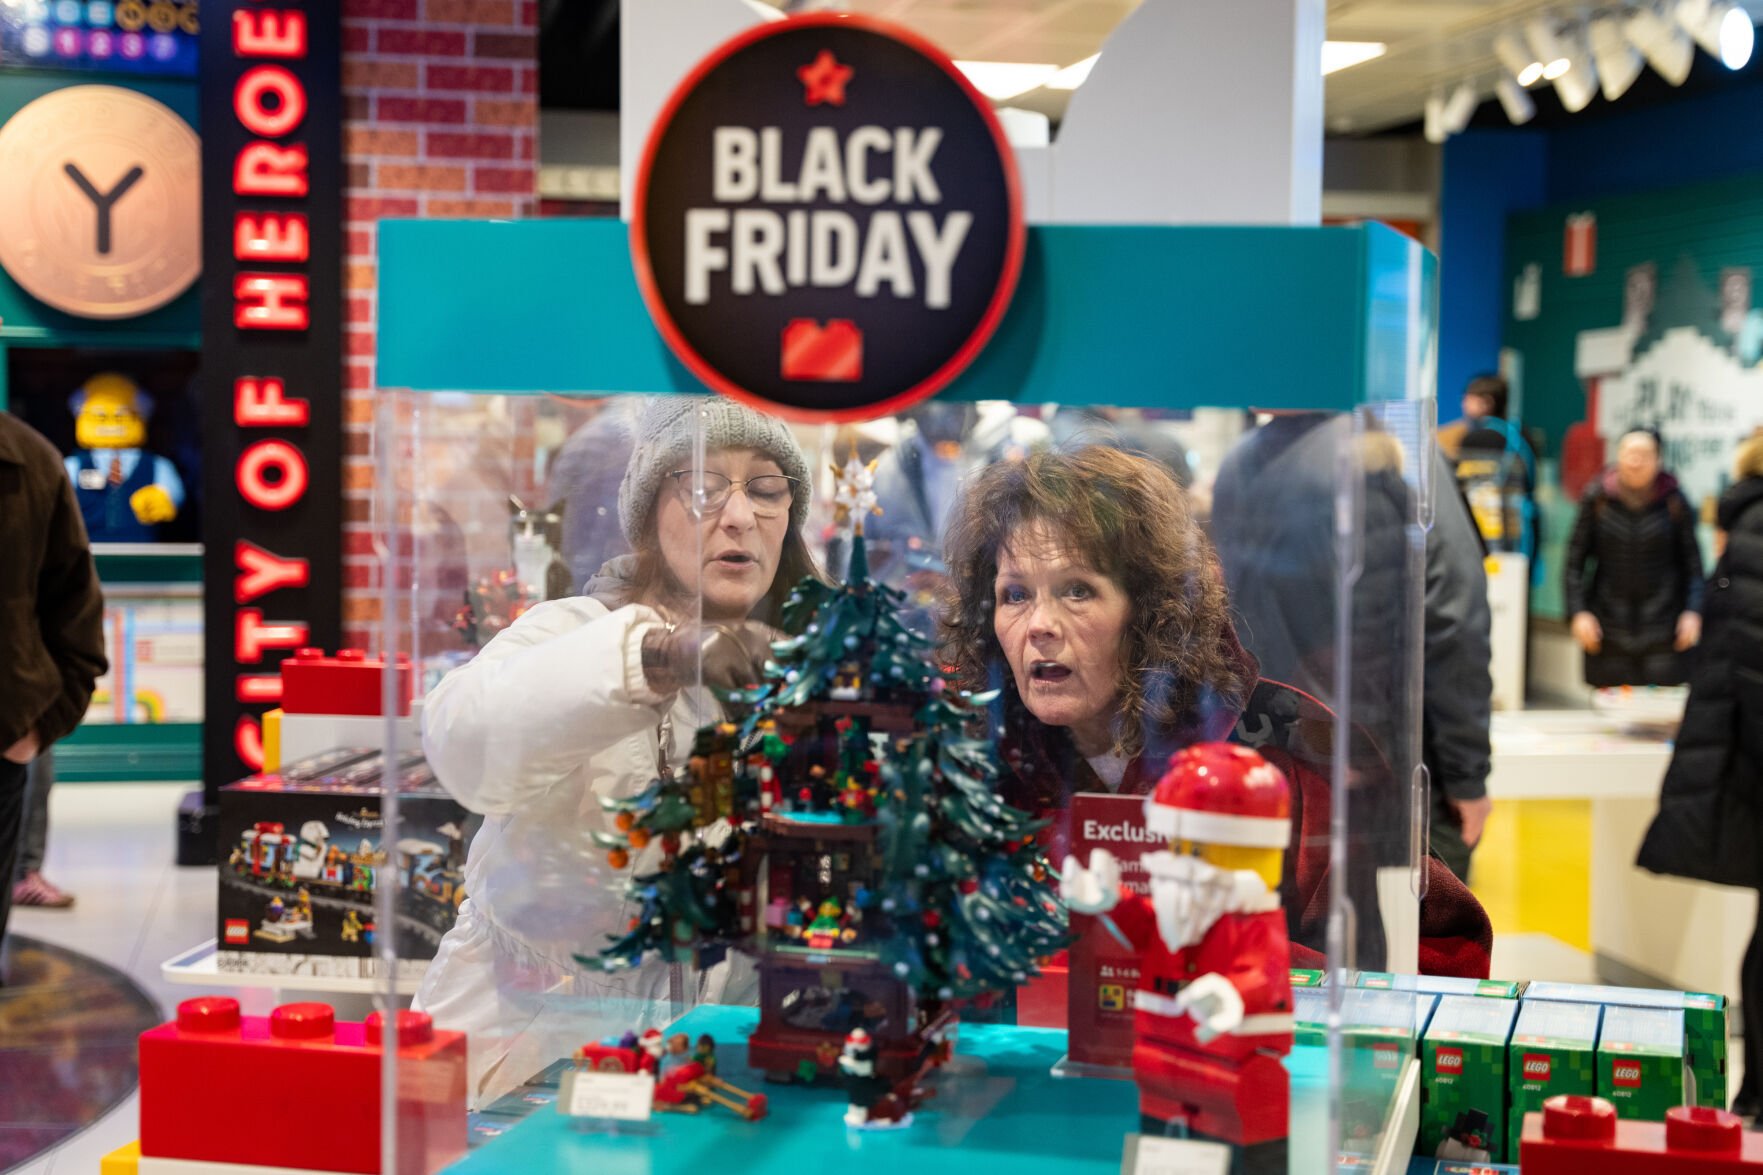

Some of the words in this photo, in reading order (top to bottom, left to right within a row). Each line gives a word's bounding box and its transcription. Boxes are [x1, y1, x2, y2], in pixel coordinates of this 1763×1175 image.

[232, 0, 309, 331] HEROE
[713, 127, 943, 203] BLACK
[64, 162, 144, 254] Y
[684, 208, 974, 309] FRIDAY
[234, 376, 309, 511] OF
[1438, 1055, 1461, 1067] LEGO
[1525, 1061, 1549, 1073] LEGO
[1616, 1067, 1639, 1079] LEGO
